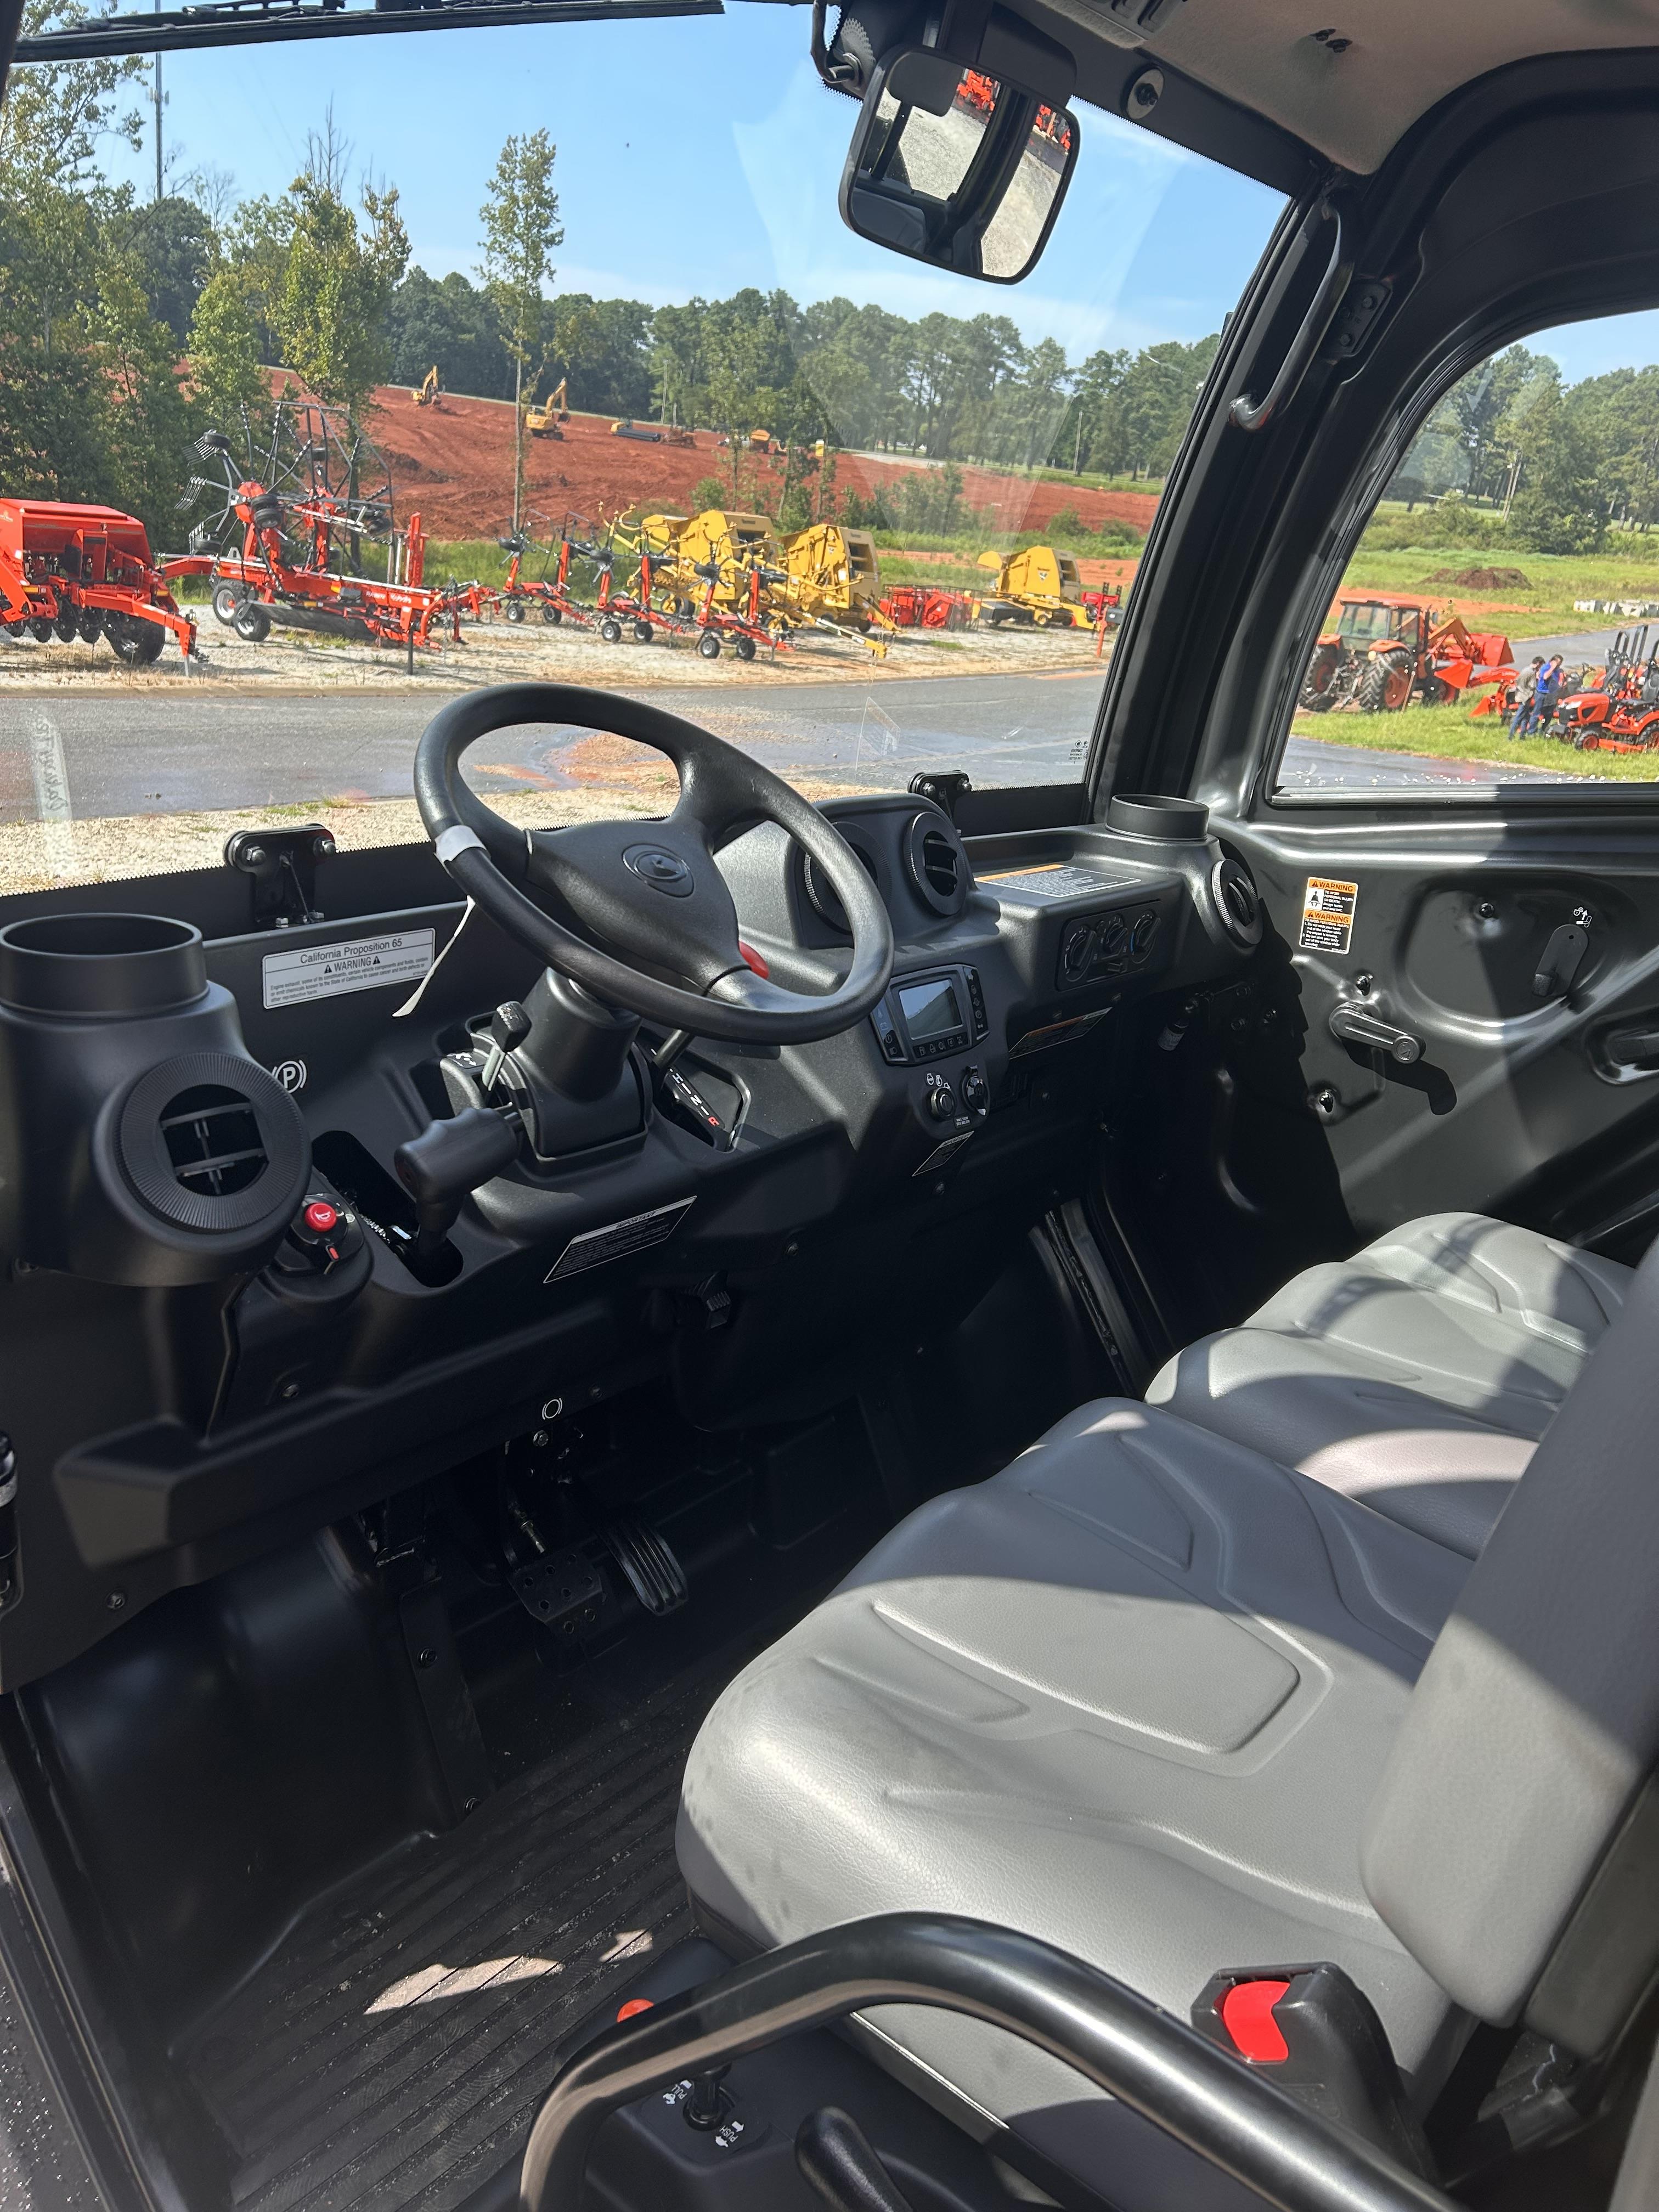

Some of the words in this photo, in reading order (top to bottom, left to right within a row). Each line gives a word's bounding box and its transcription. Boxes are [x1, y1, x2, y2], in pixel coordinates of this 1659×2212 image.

[1319, 881, 1353, 891] WARNING
[1315, 912, 1348, 923] WARNING
[301, 949, 341, 964] California
[344, 941, 390, 956] Proposition
[392, 938, 402, 947] 65
[334, 957, 371, 972] WARNING
[283, 1066, 296, 1088] P
[673, 1073, 684, 1084] H
[690, 1094, 702, 1106] N
[708, 1116, 720, 1126] R
[672, 2084, 687, 2100] PULL
[720, 2125, 738, 2142] PUSH
